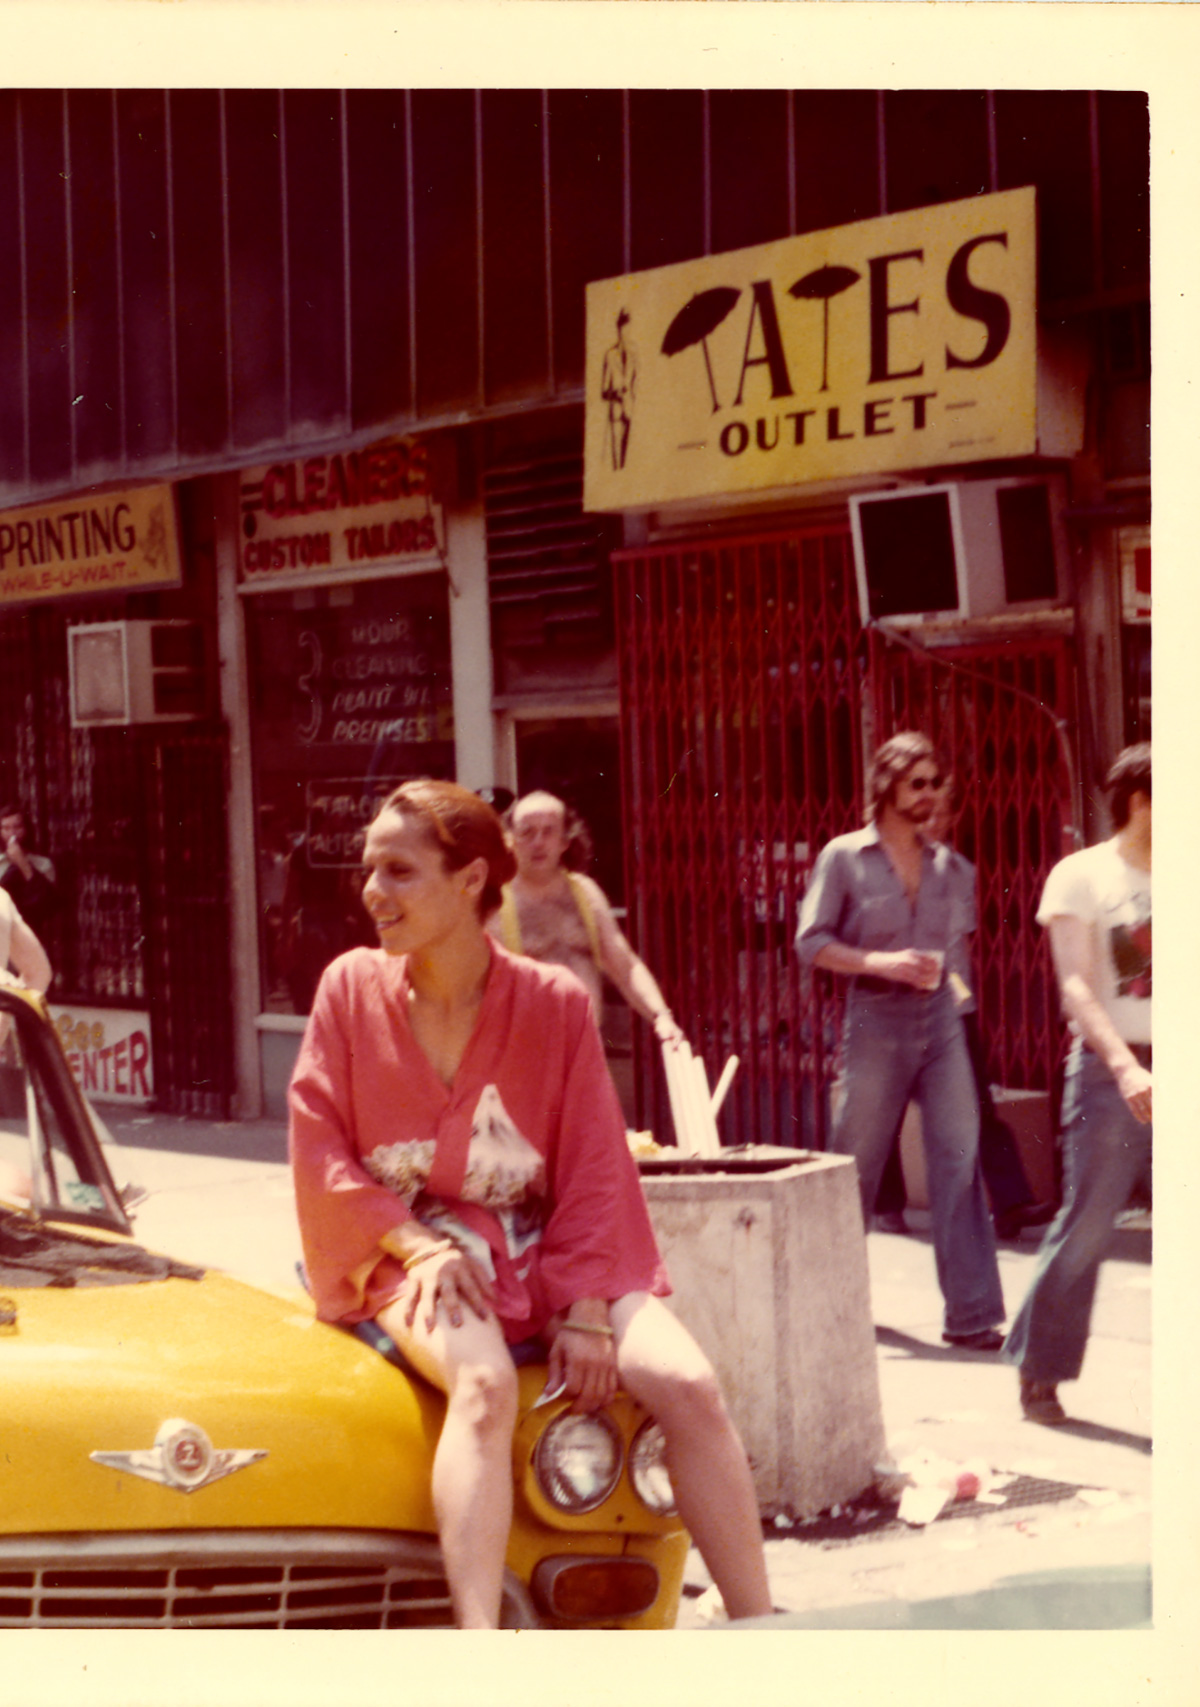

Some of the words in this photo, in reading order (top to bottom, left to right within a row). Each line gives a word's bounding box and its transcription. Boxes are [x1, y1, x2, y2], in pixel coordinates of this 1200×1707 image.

[660, 231, 1011, 414] TATES
[719, 392, 938, 457] OUTLET
[244, 531, 331, 573] CUSTOM
[343, 514, 436, 561] TAILORS
[351, 619, 410, 645] HOUR
[332, 718, 429, 744] PREMISES
